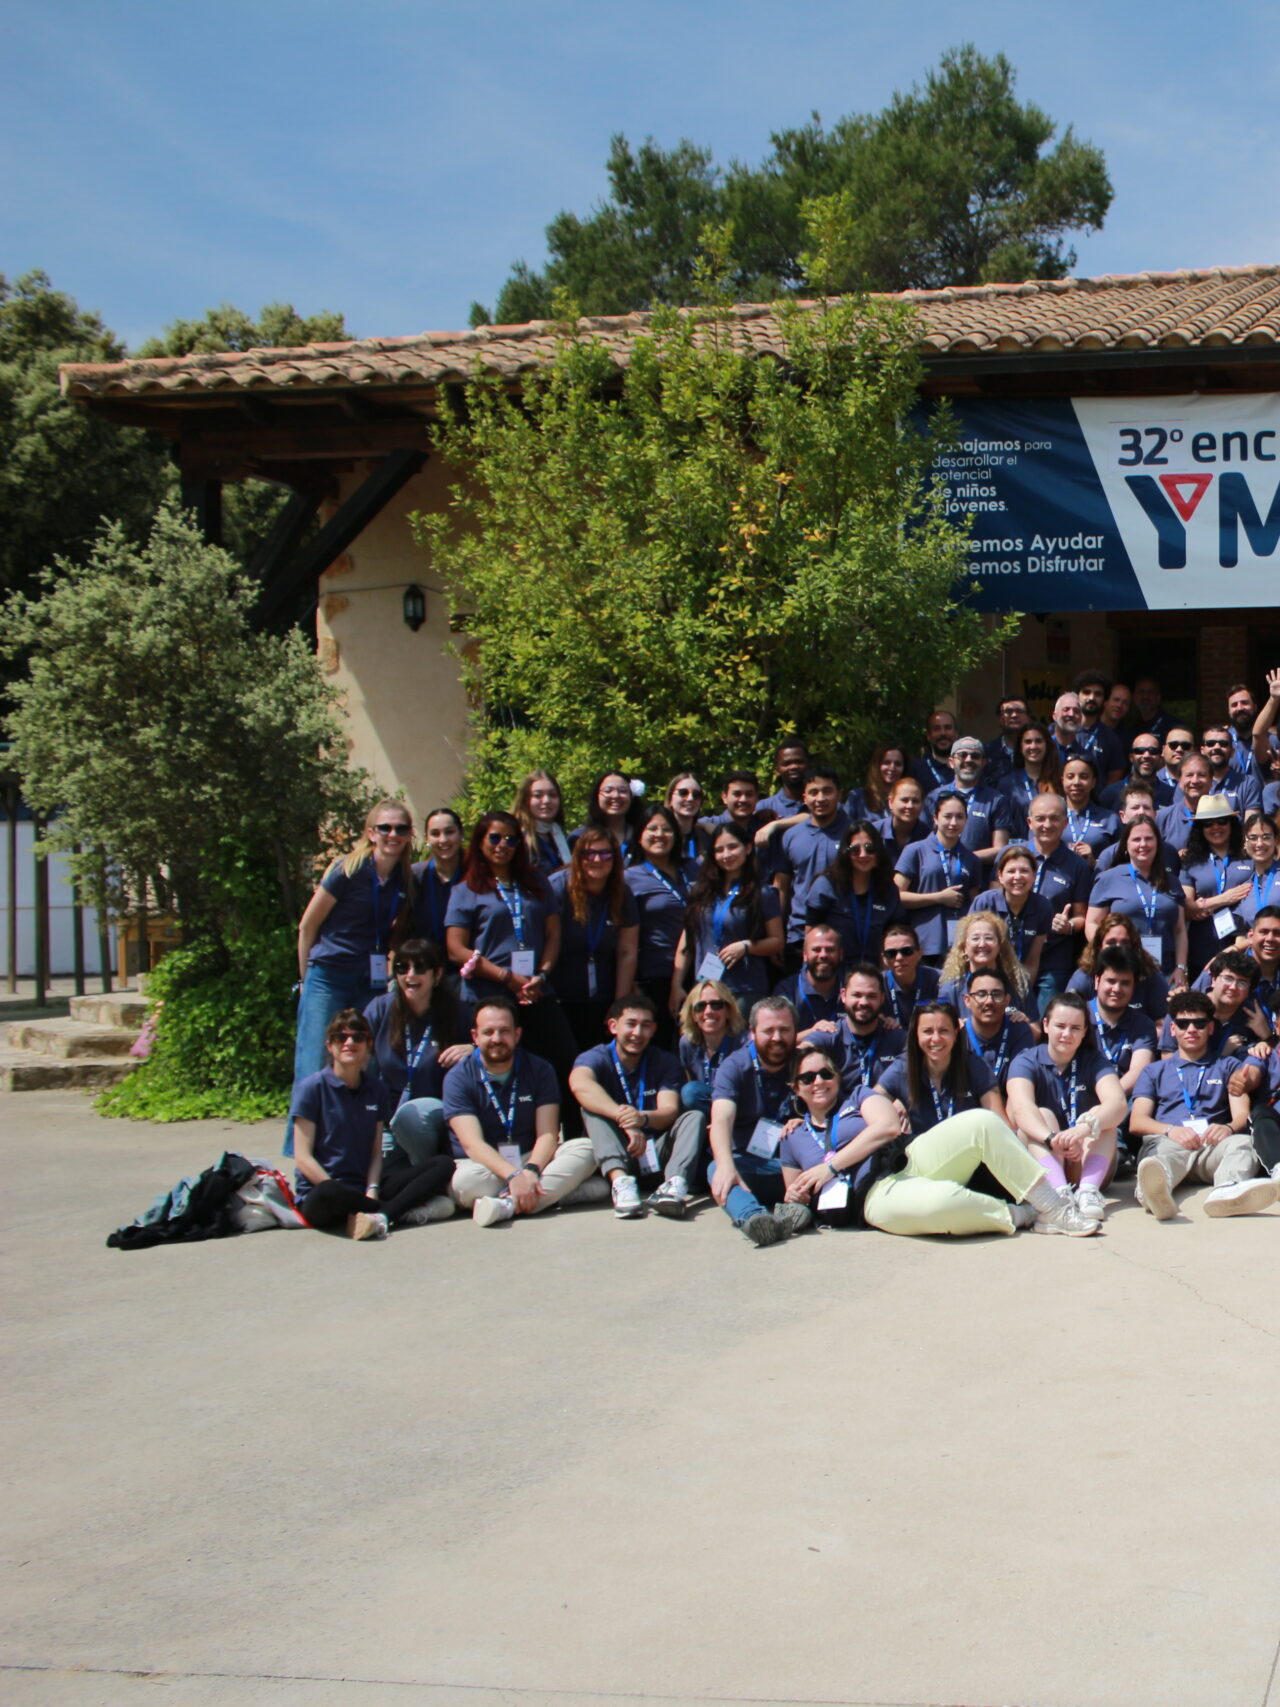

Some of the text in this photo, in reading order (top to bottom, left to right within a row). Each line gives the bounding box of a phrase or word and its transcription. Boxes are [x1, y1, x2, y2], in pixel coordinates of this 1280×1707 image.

[1024, 441, 1052, 453] para
[931, 455, 1017, 468] desarrollar el
[931, 468, 992, 483] potencial
[956, 484, 997, 498] niños
[945, 499, 1009, 516] jóvenes.
[1030, 532, 1105, 554] Ayudar
[1027, 555, 1105, 574] Disfrutar
